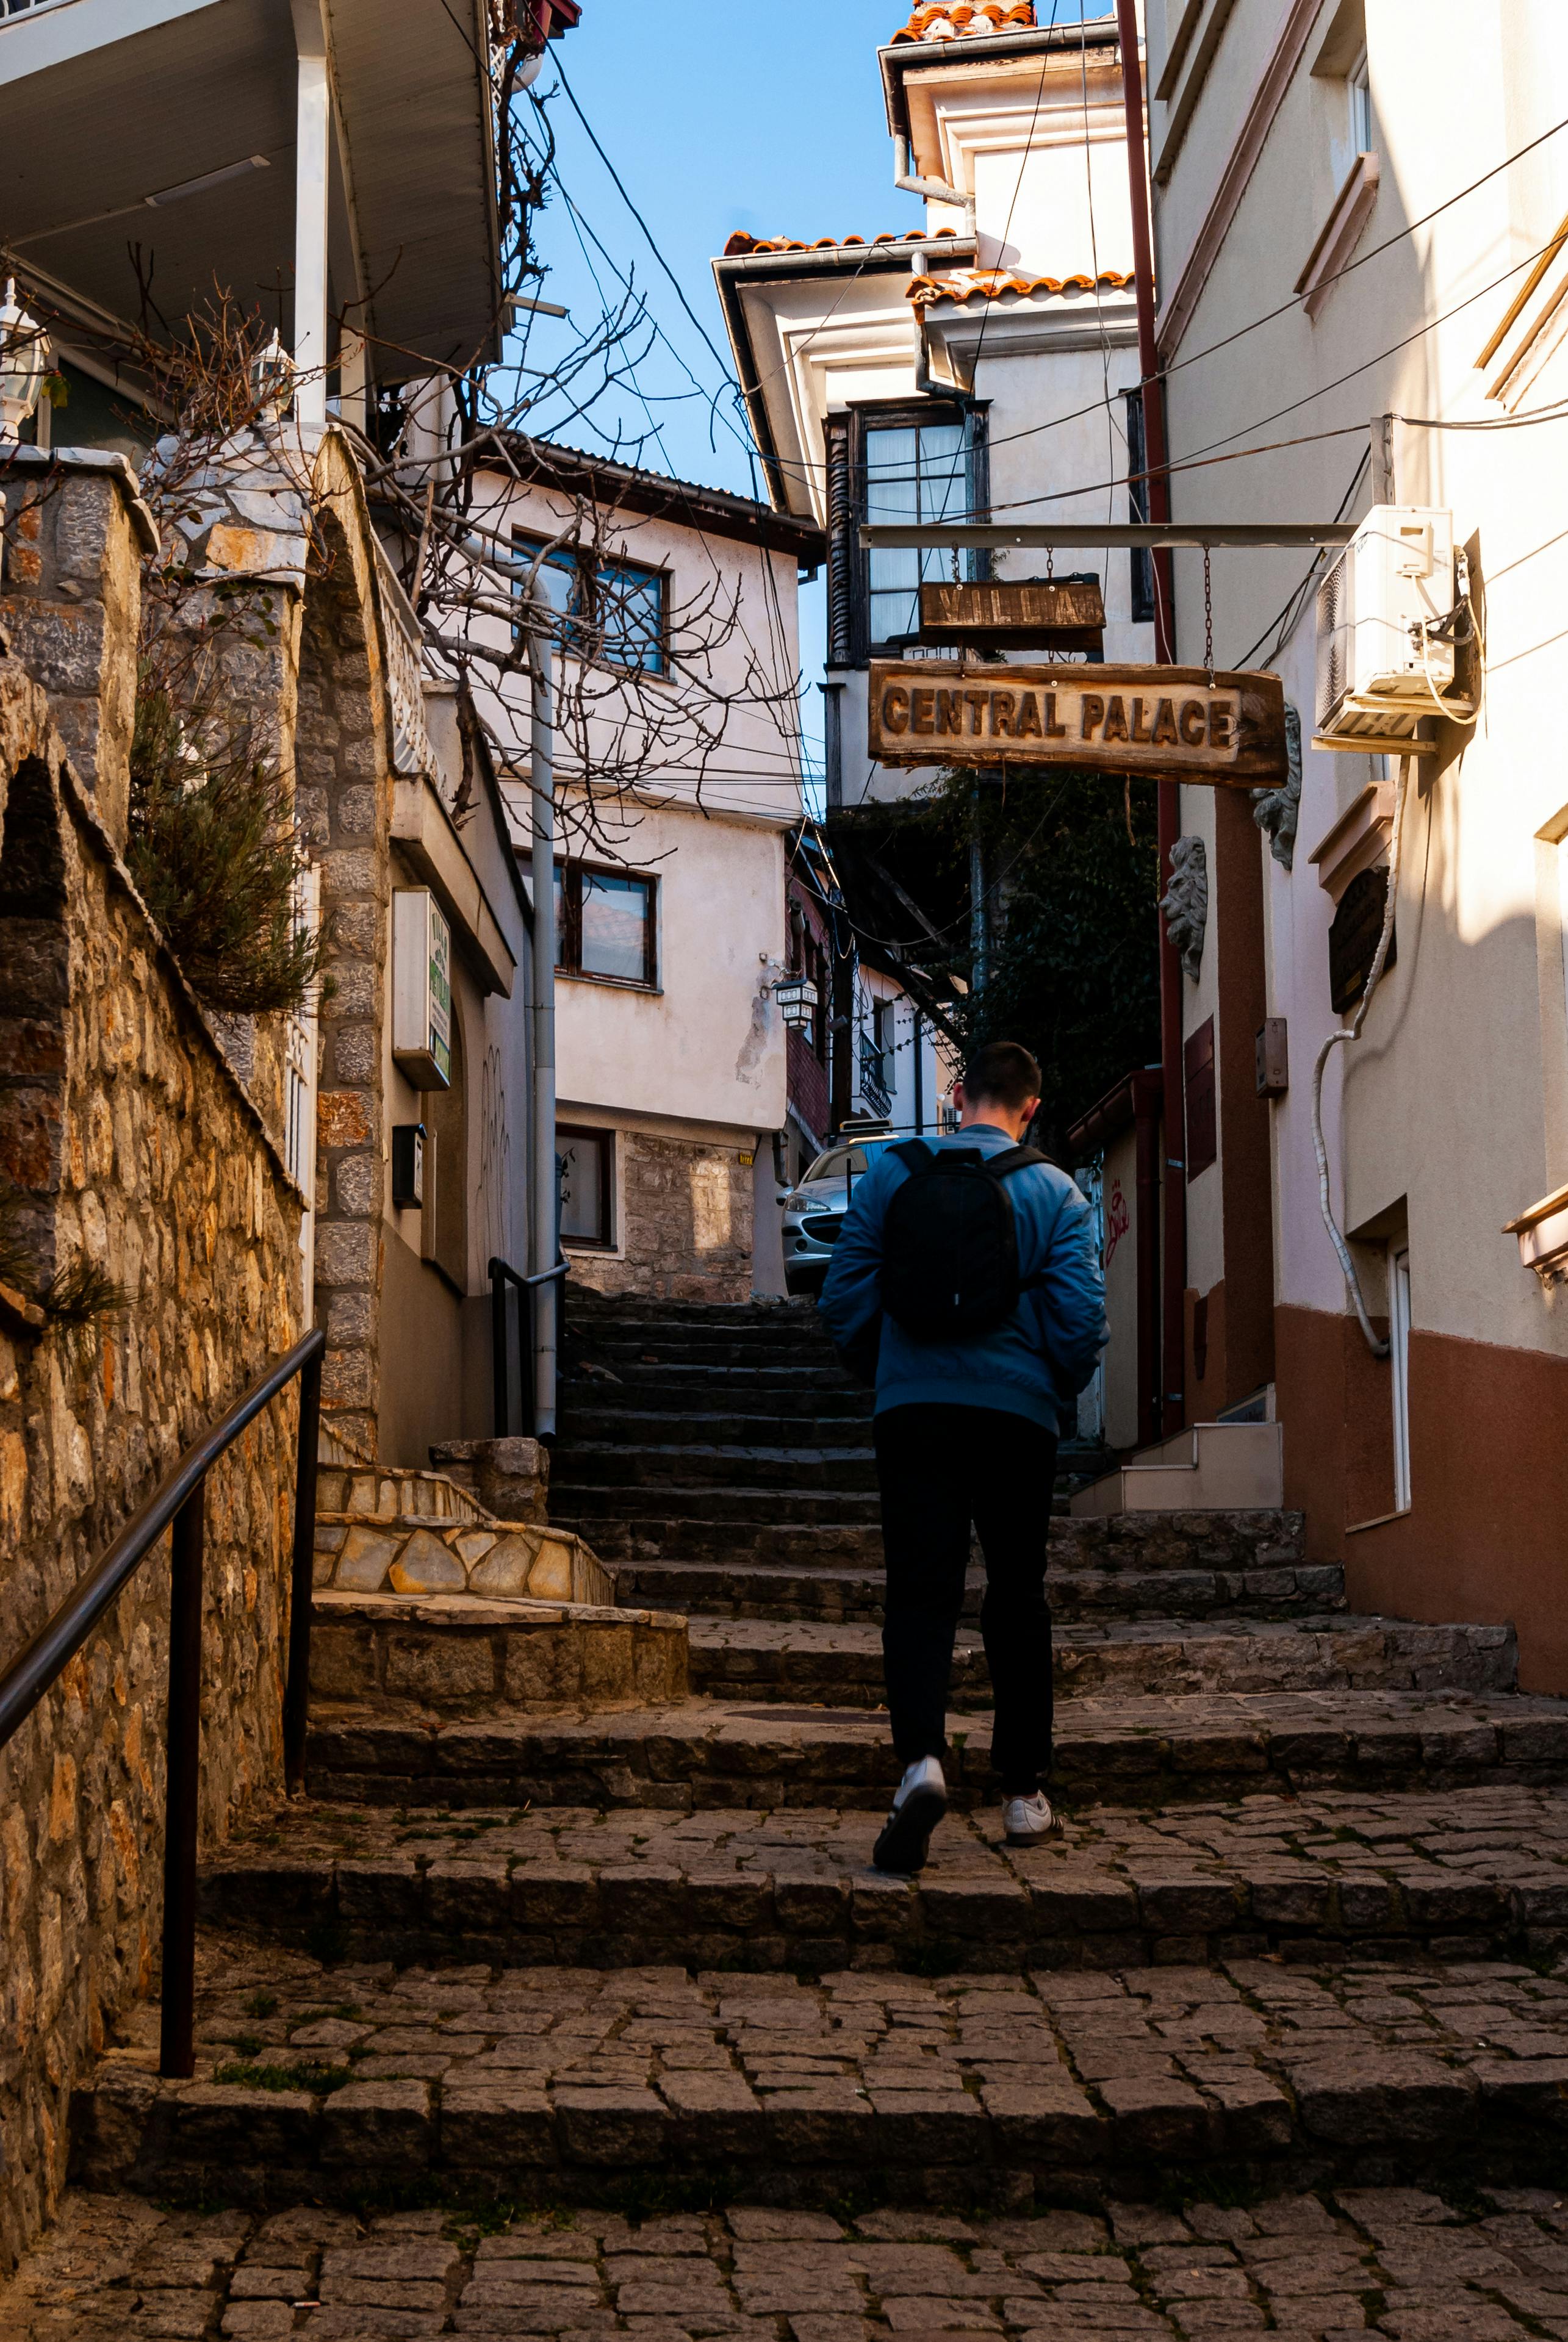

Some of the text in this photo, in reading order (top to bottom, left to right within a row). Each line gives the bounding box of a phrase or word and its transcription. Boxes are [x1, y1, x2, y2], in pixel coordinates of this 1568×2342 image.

[938, 588, 1081, 623] VILLA
[882, 686, 1232, 748] CENTRAL PALACE
